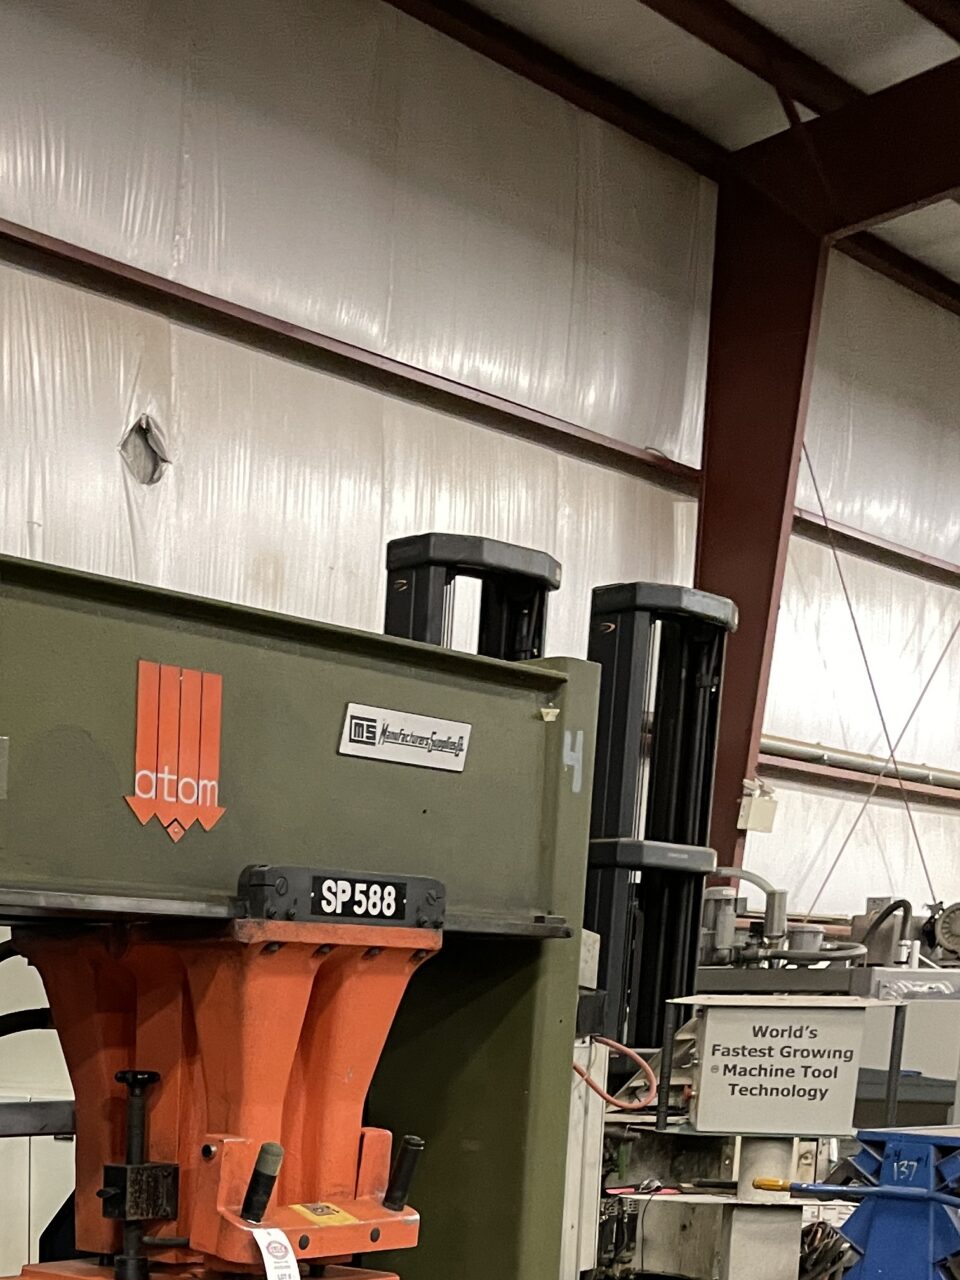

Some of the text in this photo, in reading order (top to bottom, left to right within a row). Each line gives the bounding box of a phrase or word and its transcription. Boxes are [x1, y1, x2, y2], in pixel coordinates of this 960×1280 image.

[135, 765, 219, 807] atom
[321, 879, 396, 917] SP588
[752, 1025, 818, 1039] World's
[711, 1044, 854, 1062] Fastest Growing
[723, 1064, 838, 1079] Machine Tool
[728, 1083, 829, 1101] Technology
[893, 1160, 918, 1181] 137
